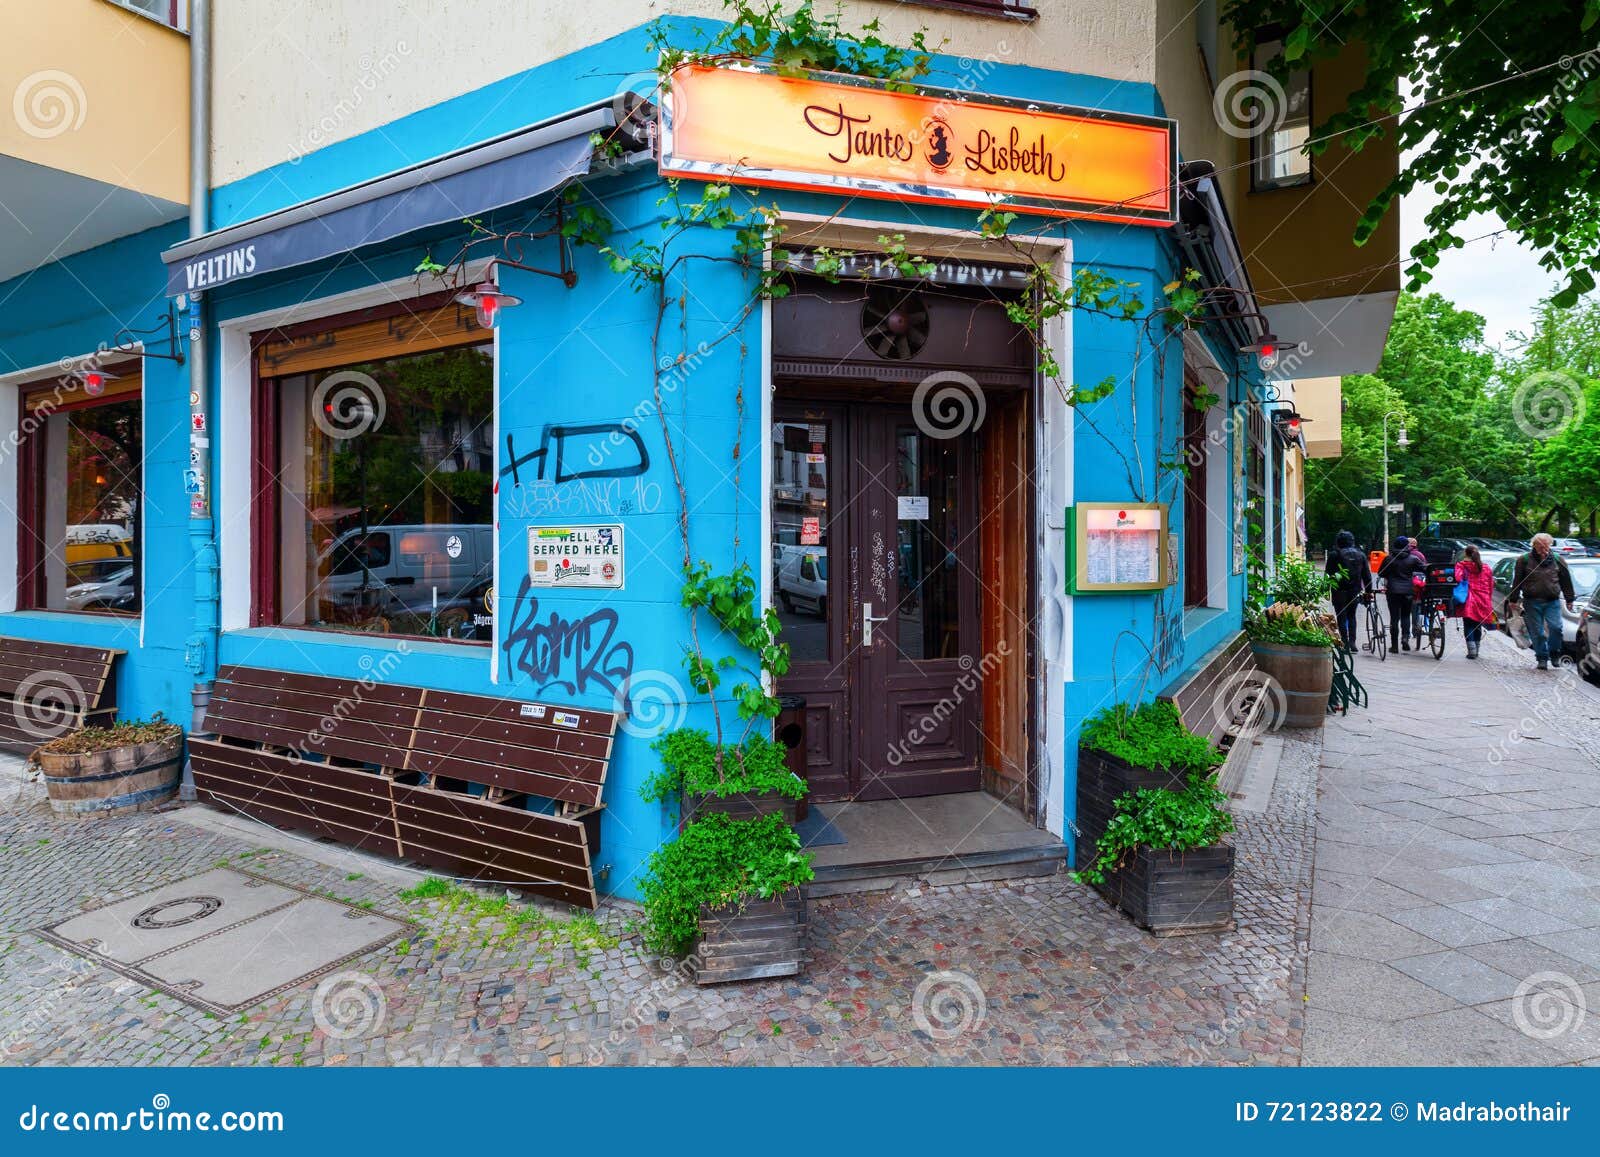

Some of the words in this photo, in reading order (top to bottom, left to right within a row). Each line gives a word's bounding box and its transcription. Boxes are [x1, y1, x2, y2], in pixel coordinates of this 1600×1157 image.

[804, 103, 913, 163] Tante
[964, 126, 1065, 182] Lisbeth
[186, 245, 256, 289] VELTINS
[560, 532, 590, 542] WELL
[534, 545, 579, 555] SERVED
[585, 545, 619, 555] HERE
[473, 613, 493, 626] Jäger
